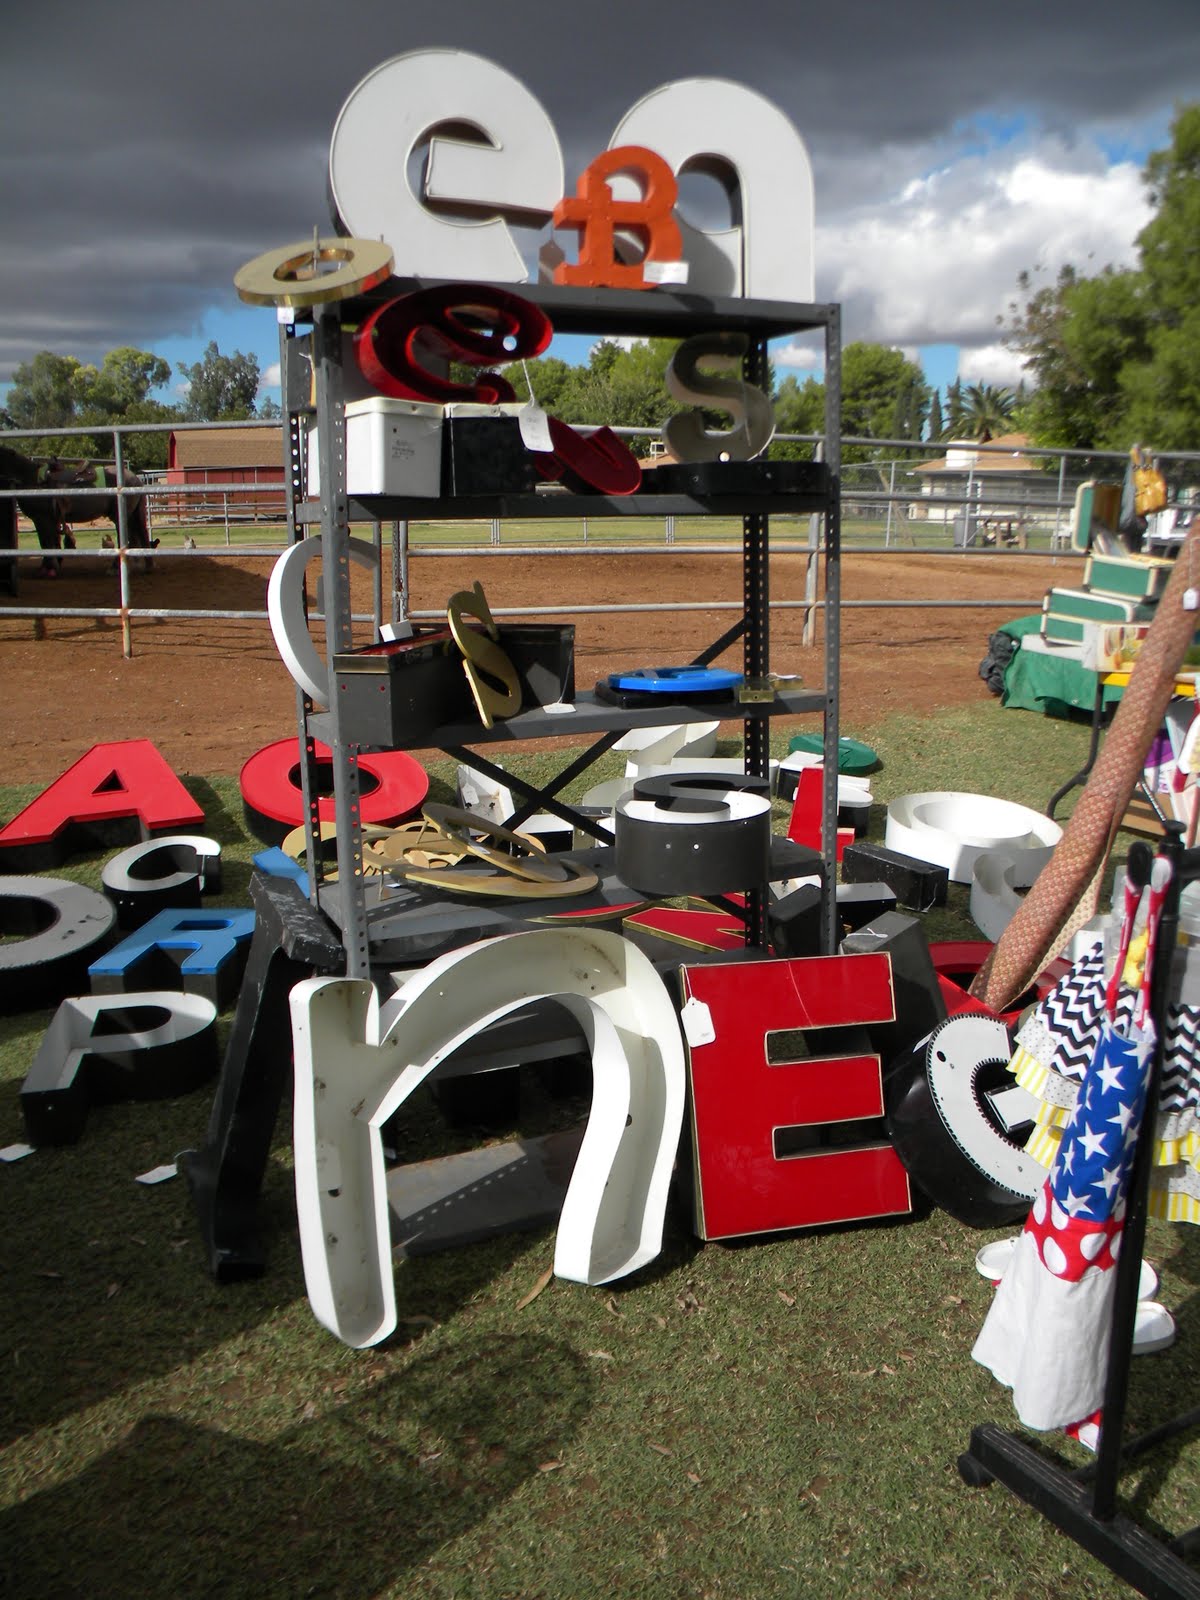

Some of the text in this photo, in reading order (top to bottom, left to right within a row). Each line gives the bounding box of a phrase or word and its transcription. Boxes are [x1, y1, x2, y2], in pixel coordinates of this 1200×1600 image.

[0, 738, 205, 850] A
[88, 908, 256, 977] R
[20, 991, 217, 1100] P
[680, 952, 913, 1241] E
